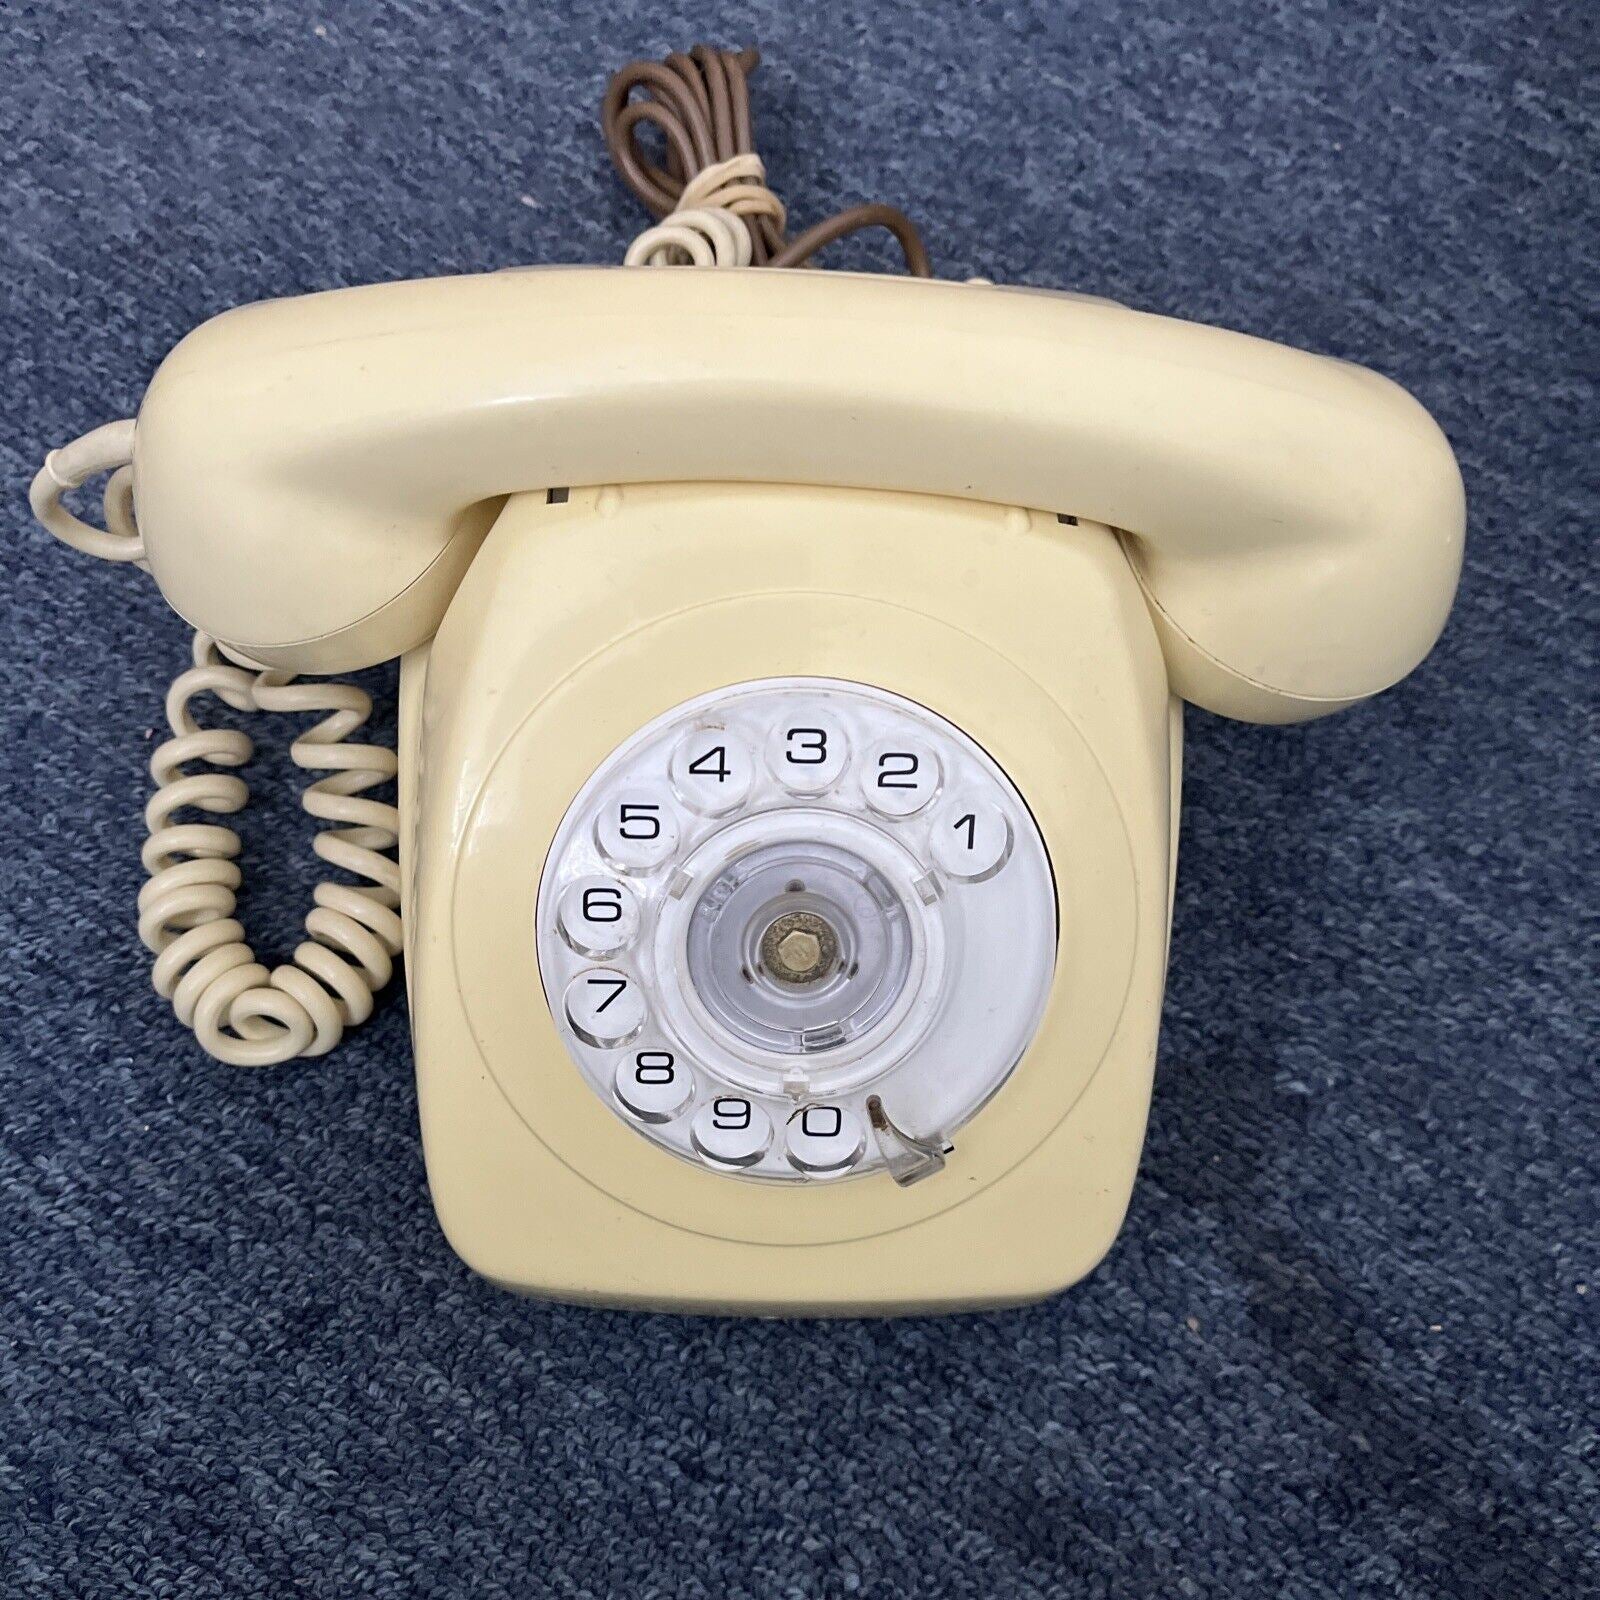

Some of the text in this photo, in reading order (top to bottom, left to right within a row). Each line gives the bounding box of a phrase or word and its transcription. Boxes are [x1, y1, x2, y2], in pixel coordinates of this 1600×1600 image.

[688, 746, 732, 783] 4
[785, 728, 827, 765] 3
[877, 752, 919, 789] 2
[619, 804, 660, 840] 5
[953, 814, 976, 850] 1
[582, 887, 623, 923] 6
[587, 978, 627, 1013] 7
[635, 1051, 675, 1085] 8
[712, 1097, 752, 1130] 9
[801, 1106, 842, 1137] 0
